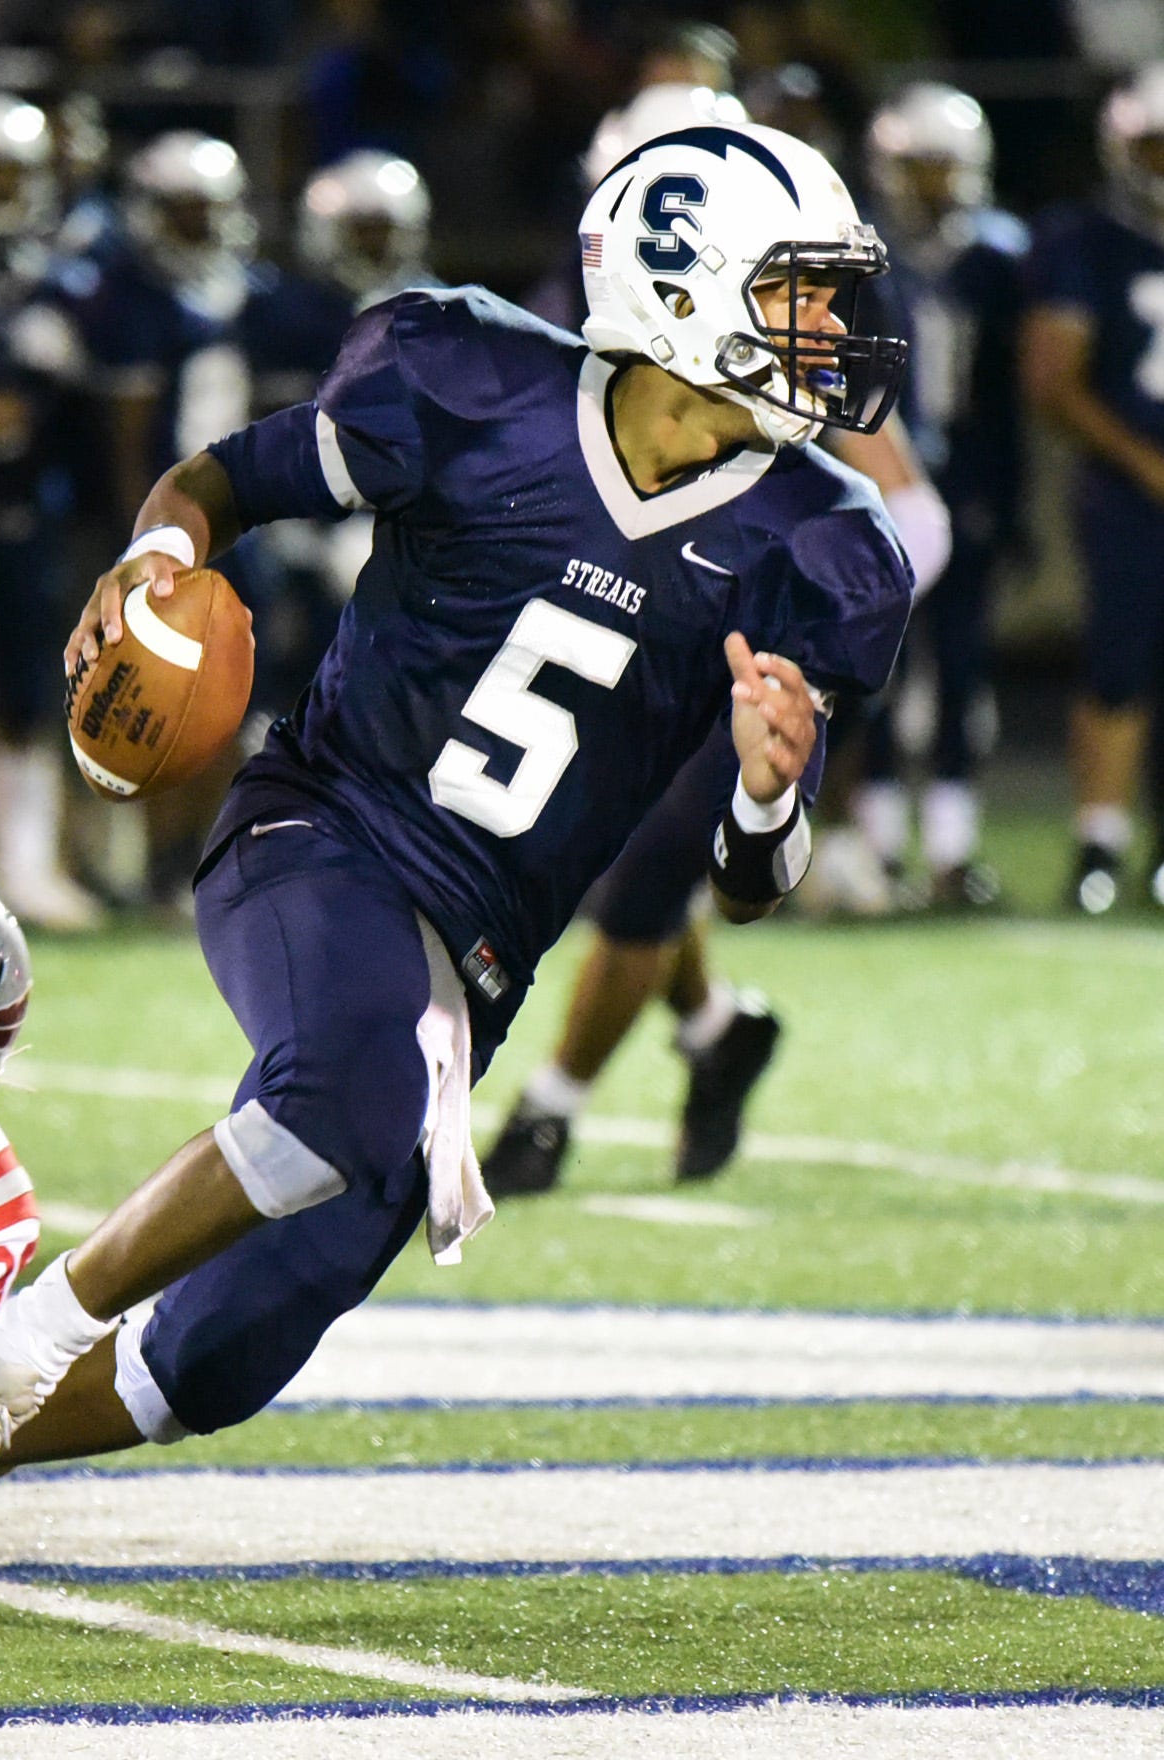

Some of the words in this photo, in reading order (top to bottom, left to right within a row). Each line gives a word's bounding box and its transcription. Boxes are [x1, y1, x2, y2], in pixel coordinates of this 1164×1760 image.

[635, 173, 708, 275] S
[561, 559, 647, 615] STREAKS
[81, 661, 134, 740] Wilson
[428, 597, 638, 838] 5
